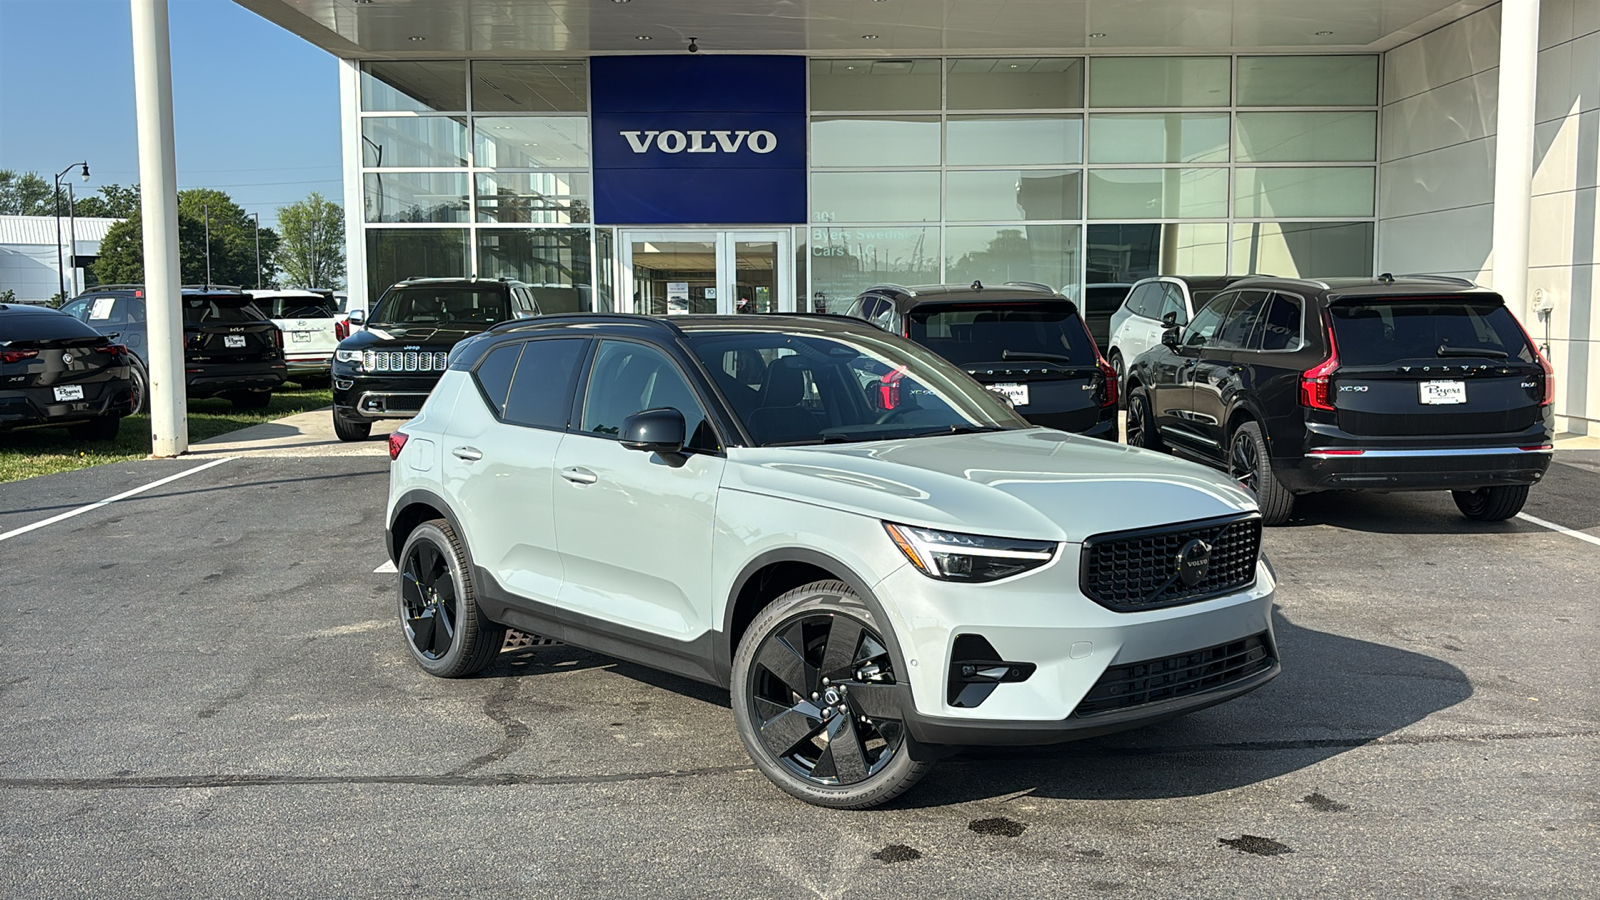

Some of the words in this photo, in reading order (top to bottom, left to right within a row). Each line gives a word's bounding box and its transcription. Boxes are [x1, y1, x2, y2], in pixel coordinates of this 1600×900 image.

[619, 130, 778, 154] VOLVO
[813, 211, 836, 222] 301
[813, 229, 851, 243] Byers
[812, 245, 845, 257] Cars
[848, 244, 875, 256] LLC
[1424, 384, 1461, 397] Byers
[1186, 558, 1208, 567] VOLVO
[758, 615, 774, 630] R20
[805, 785, 834, 796] SEASON
[818, 783, 883, 805] SCORPION
